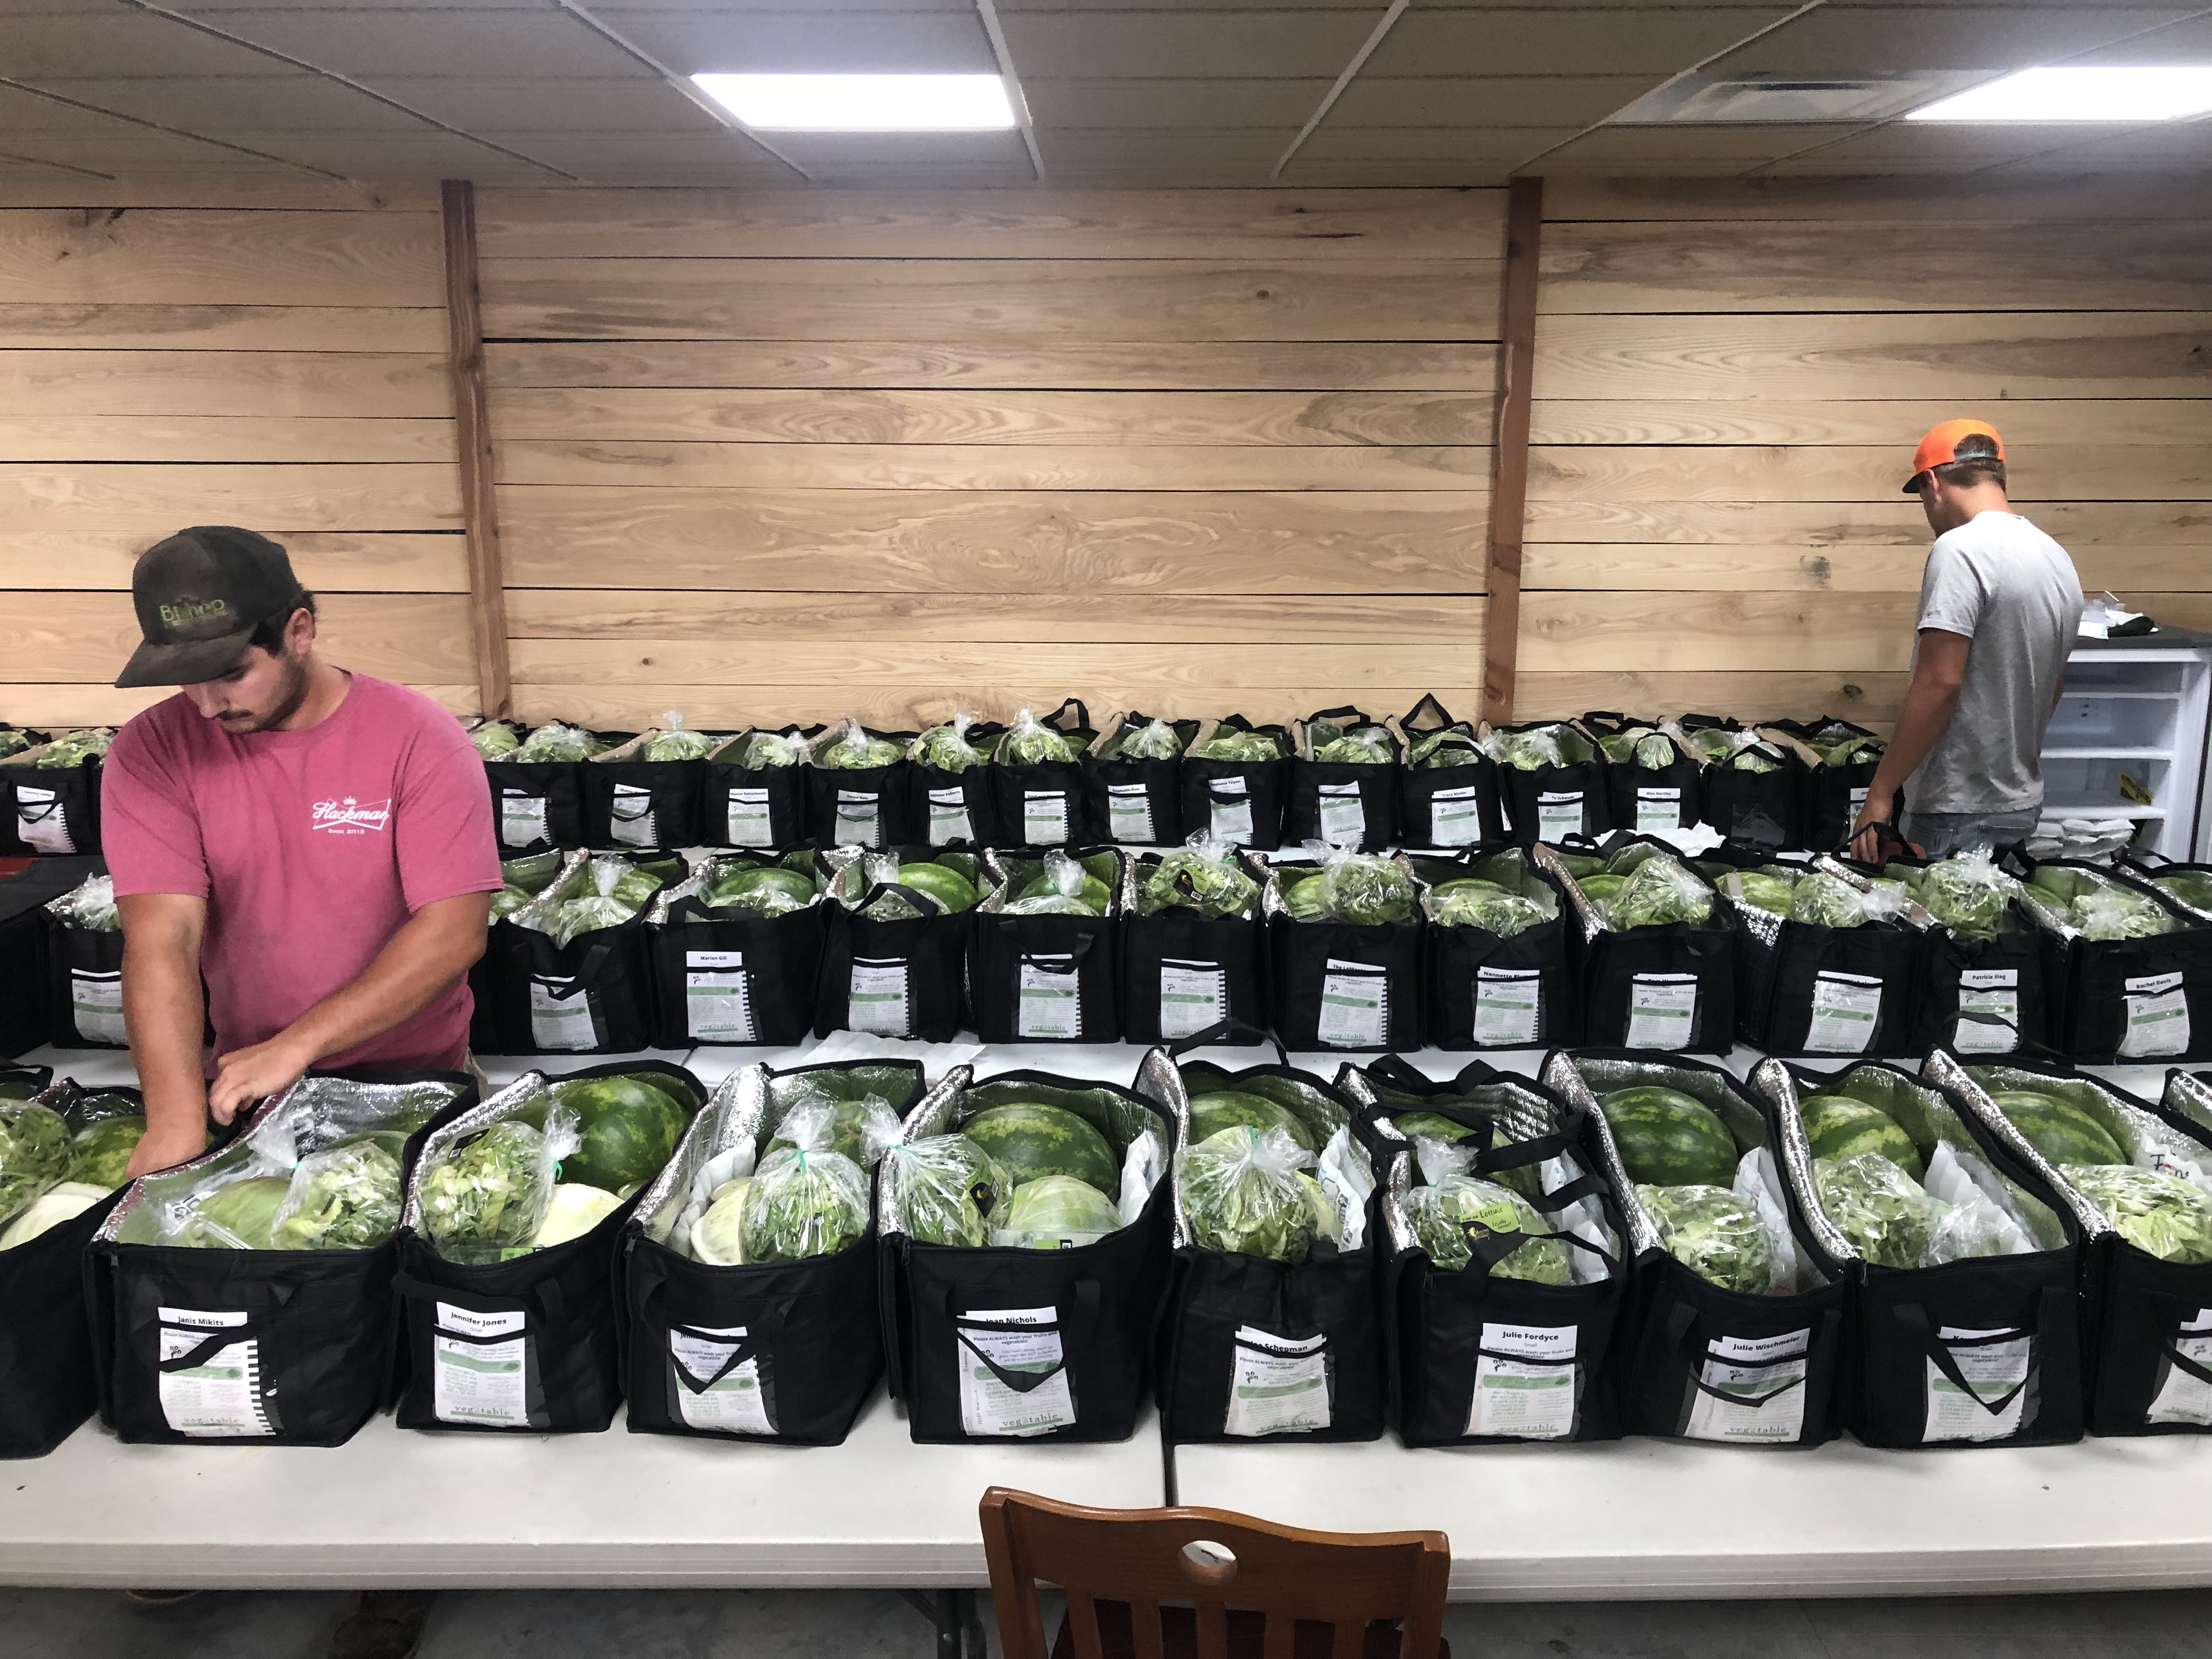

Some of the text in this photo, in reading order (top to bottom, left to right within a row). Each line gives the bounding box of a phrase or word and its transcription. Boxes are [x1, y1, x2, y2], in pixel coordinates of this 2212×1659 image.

[312, 802, 390, 821] Hackman
[1479, 1207, 1504, 1218] Lettuce
[178, 1316, 196, 1324] Janis
[451, 1312, 507, 1327] Jennifer Jones
[1525, 1333, 1559, 1342] Fordyce
[1756, 1336, 1801, 1351] Wischmeier
